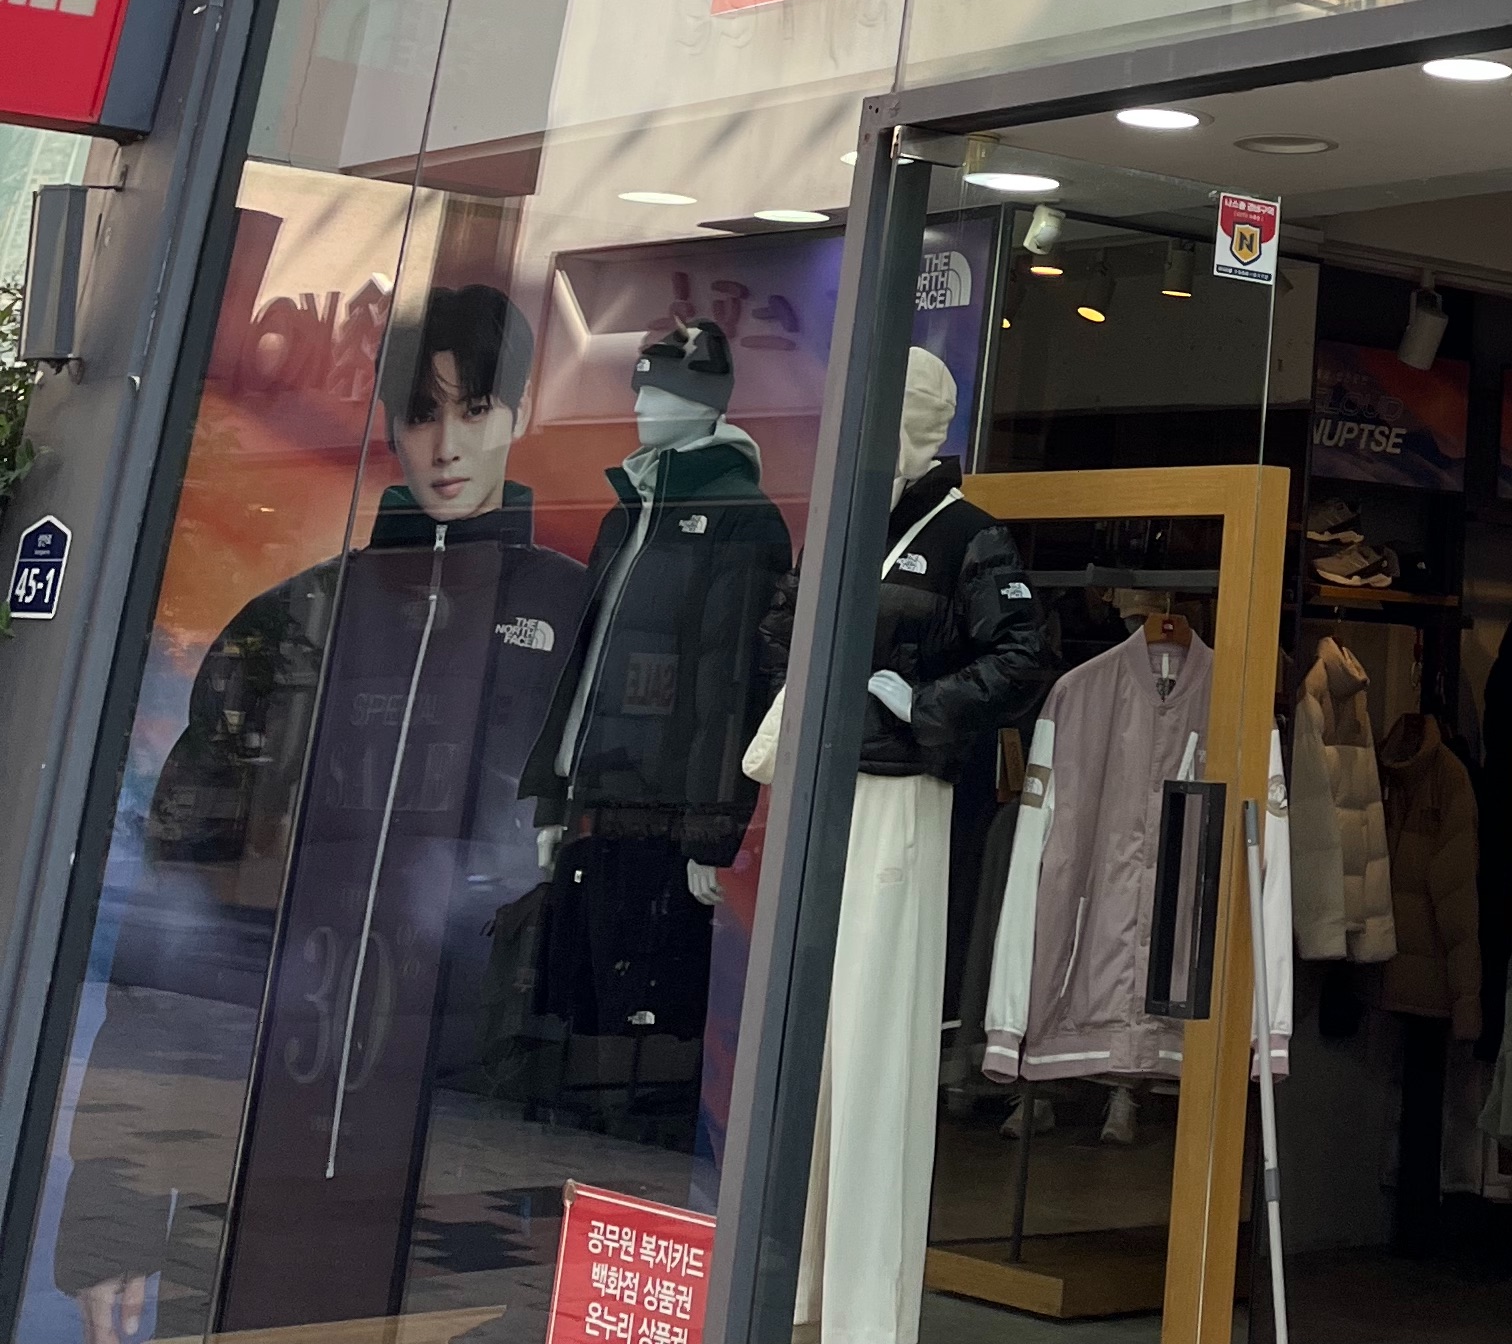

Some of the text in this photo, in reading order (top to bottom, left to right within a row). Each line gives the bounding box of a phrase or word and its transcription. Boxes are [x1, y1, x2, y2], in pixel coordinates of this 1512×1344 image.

[1238, 231, 1255, 253] N
[924, 252, 950, 272] THE
[917, 270, 948, 292] RTH
[14, 566, 56, 604] 45-1
[494, 624, 536, 639] NORTH
[515, 617, 538, 628] THE
[503, 632, 533, 648] FACE
[587, 1220, 705, 1278] 공무원 복지카드
[591, 1262, 693, 1320] 백화점 상품권
[585, 1301, 634, 1344] 온누리
